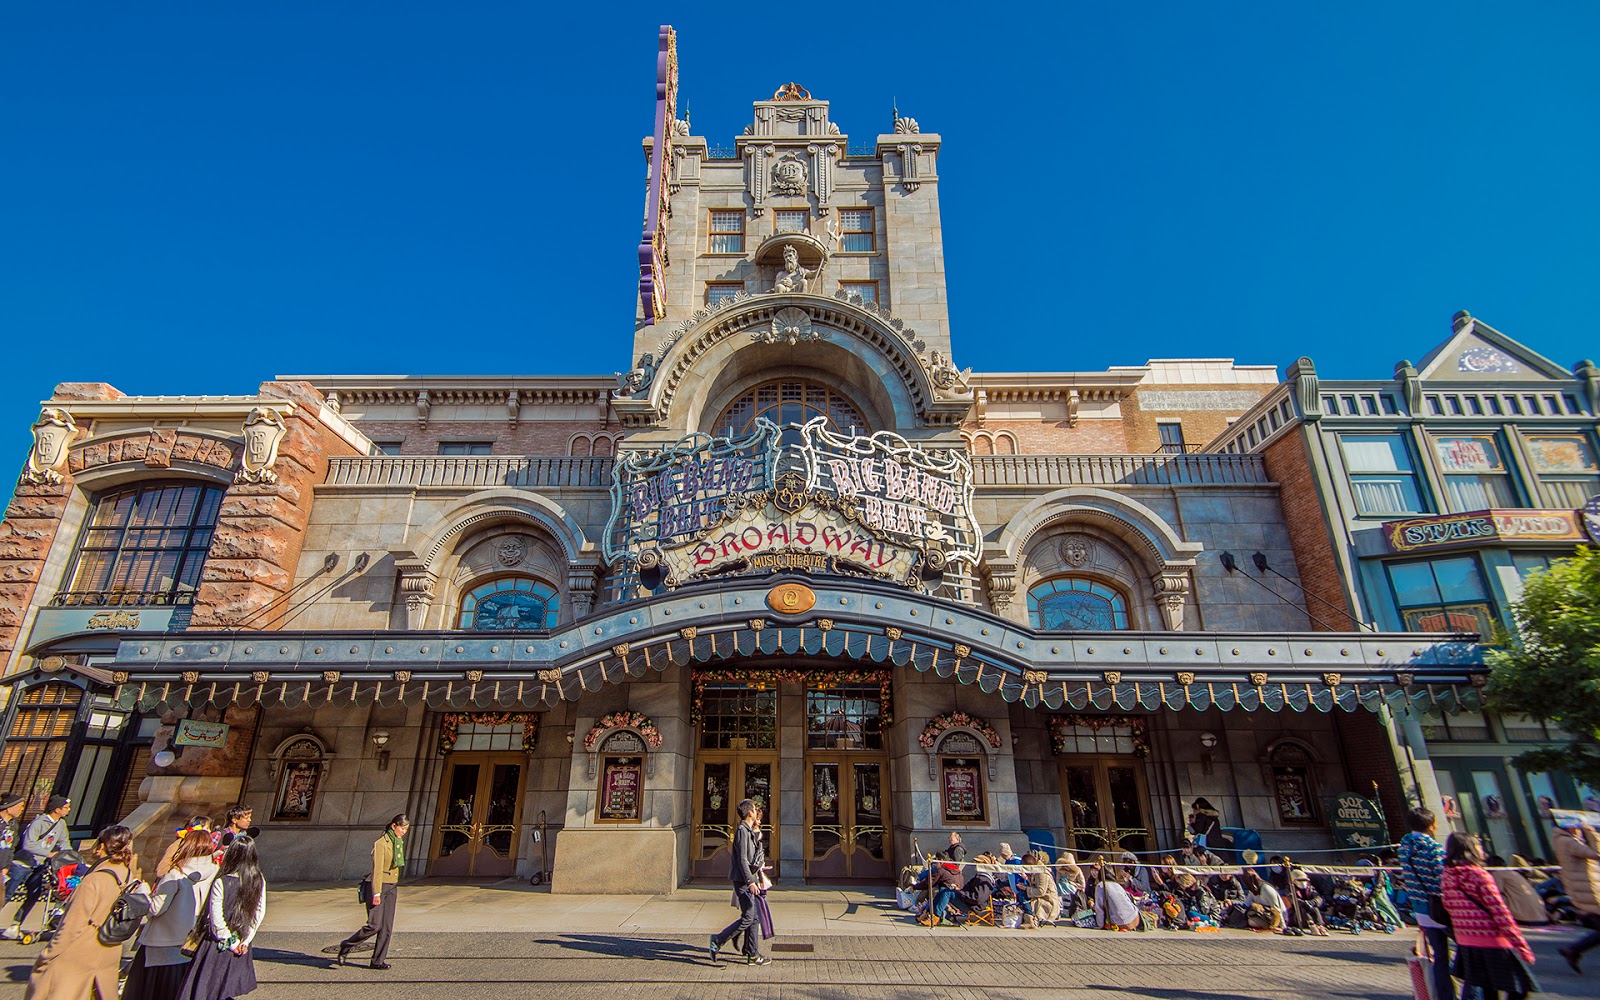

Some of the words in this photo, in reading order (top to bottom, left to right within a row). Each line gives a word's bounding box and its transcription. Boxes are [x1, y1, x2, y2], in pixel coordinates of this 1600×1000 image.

[630, 468, 676, 522] BIG
[681, 457, 755, 501] BAND
[827, 457, 881, 500] BIG
[883, 458, 954, 515] BAND
[659, 497, 720, 539] BEAT
[865, 495, 926, 538] BEAT
[688, 521, 898, 569] BROADWAY
[753, 554, 783, 569] MUSIC
[784, 553, 828, 569] THEATRE
[1338, 797, 1364, 809] BOX
[1338, 808, 1371, 819] OFFICE
